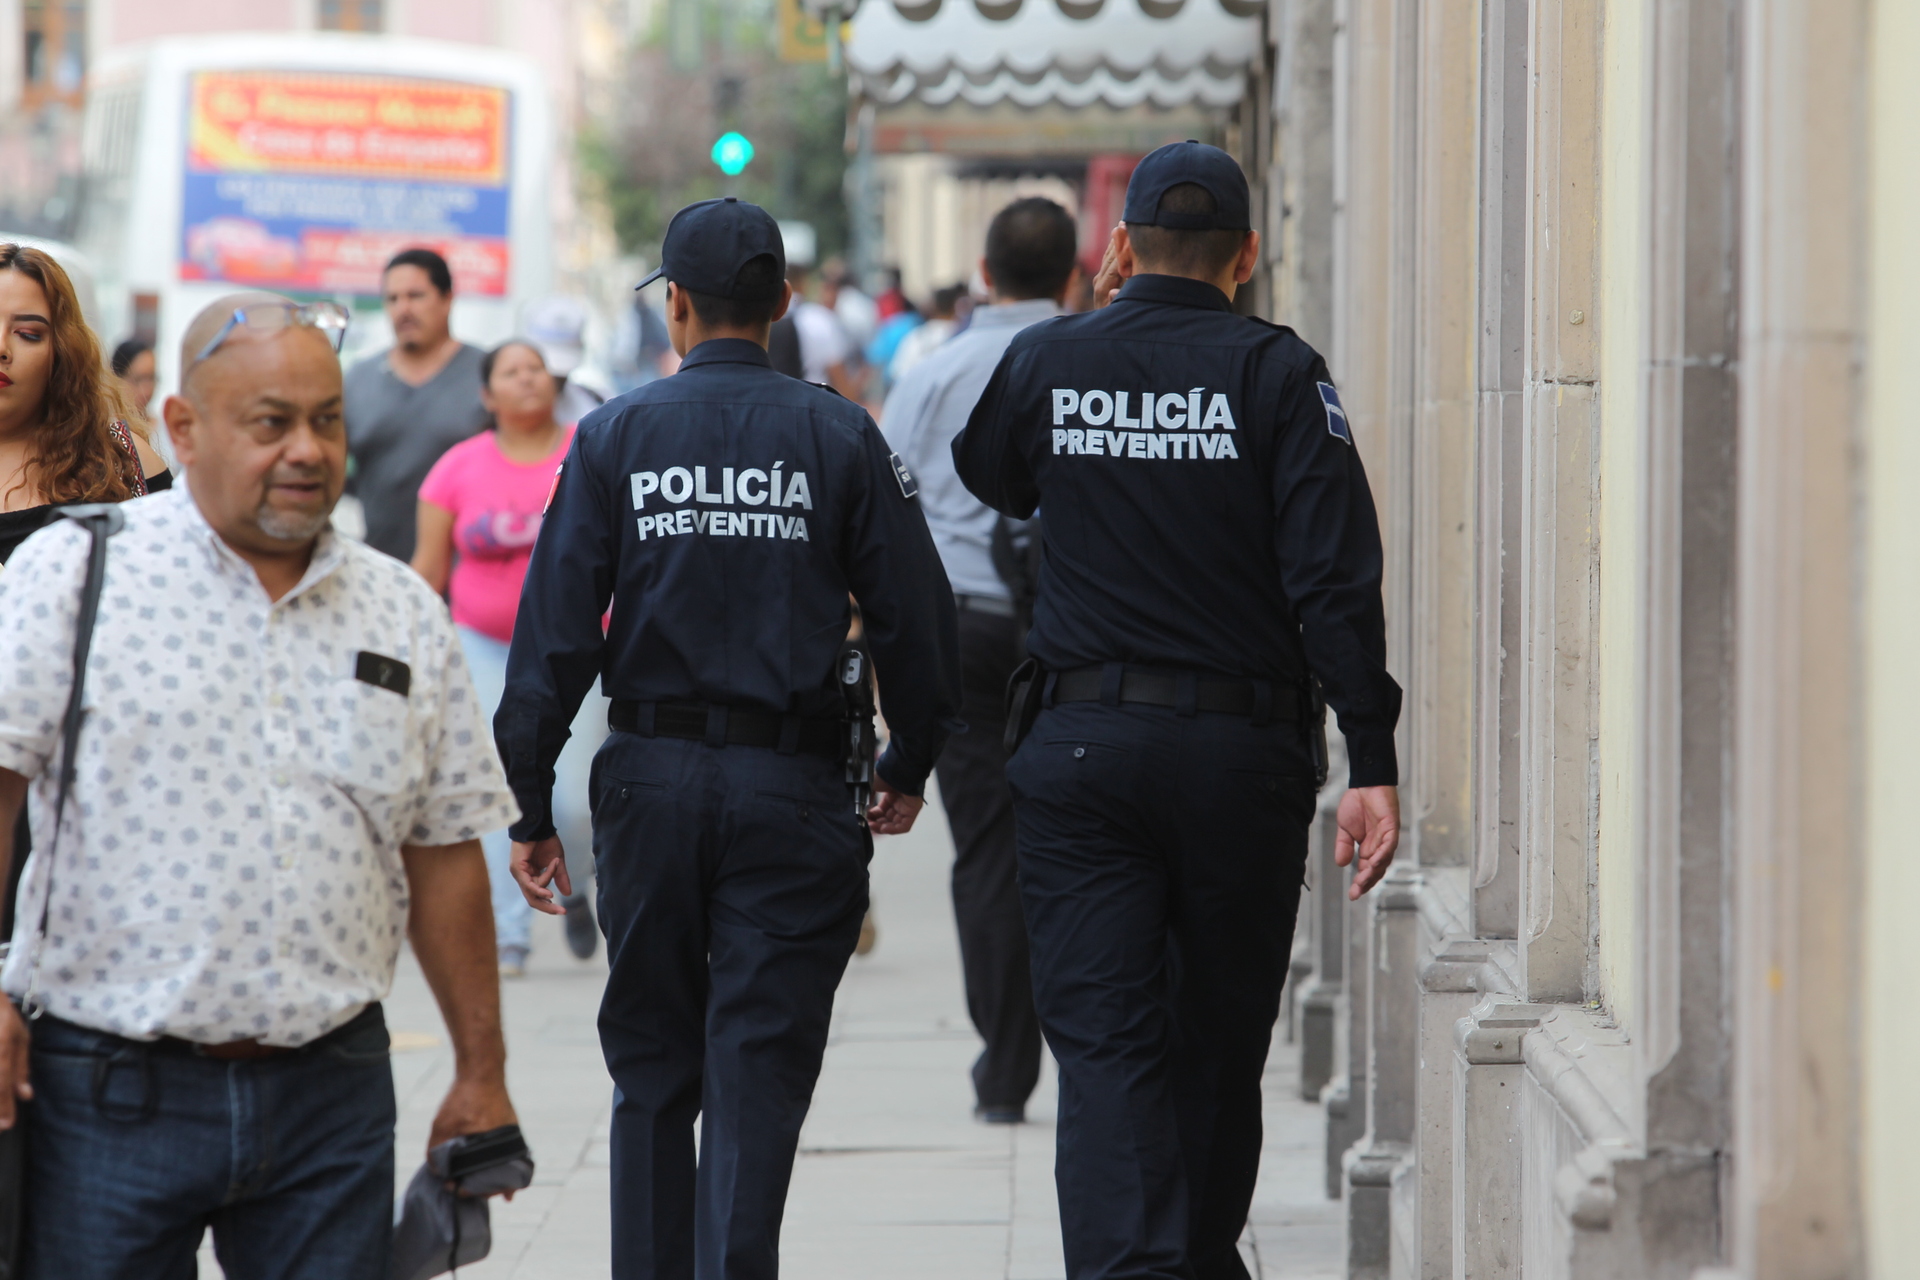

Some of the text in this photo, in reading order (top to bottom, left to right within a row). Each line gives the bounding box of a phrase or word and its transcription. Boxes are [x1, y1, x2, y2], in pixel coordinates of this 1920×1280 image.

[1051, 387, 1237, 430] POLICÍA
[1052, 428, 1239, 460] PREVENTIVA
[629, 460, 813, 511] POLICÍA
[636, 508, 810, 542] PREVENTIVA
